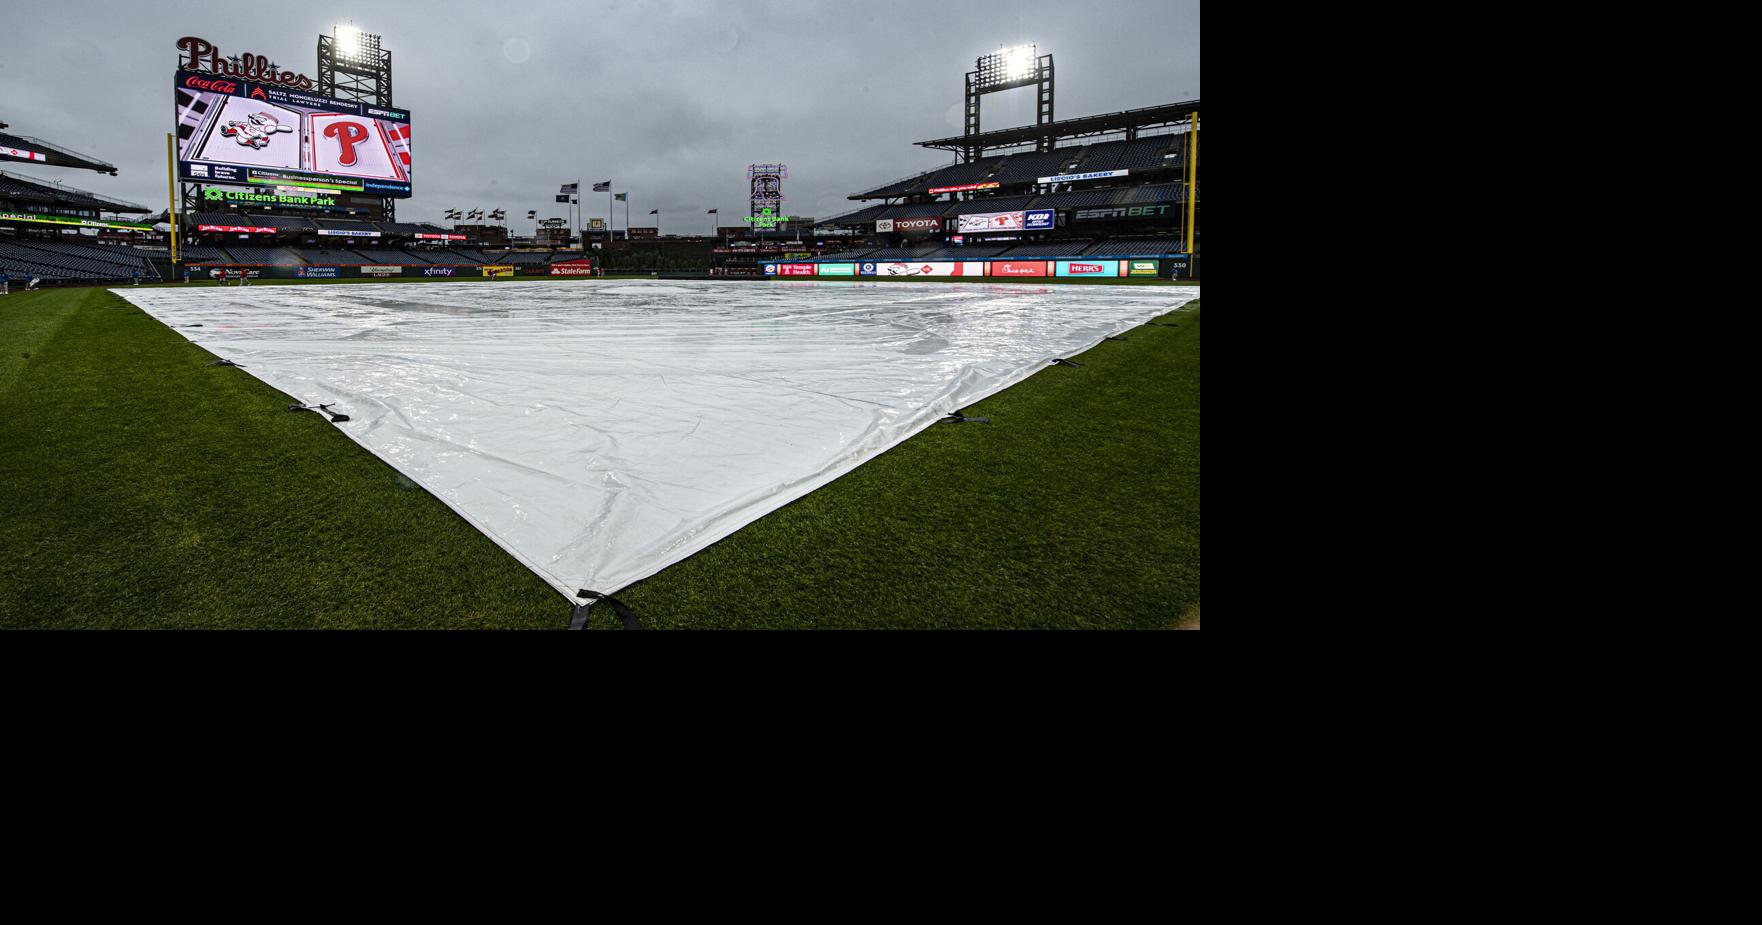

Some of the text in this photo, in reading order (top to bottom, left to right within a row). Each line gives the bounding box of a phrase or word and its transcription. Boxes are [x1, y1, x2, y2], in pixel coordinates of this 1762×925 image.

[176, 36, 312, 90] Phillies
[292, 99, 321, 107] LAWYERS
[1050, 171, 1114, 182] LISCIO'S BAKERY
[226, 191, 277, 202] Citizens
[279, 195, 308, 204] Bank
[311, 196, 335, 206] Park
[895, 219, 938, 228] TOYOTA
[424, 267, 453, 277] xfinity
